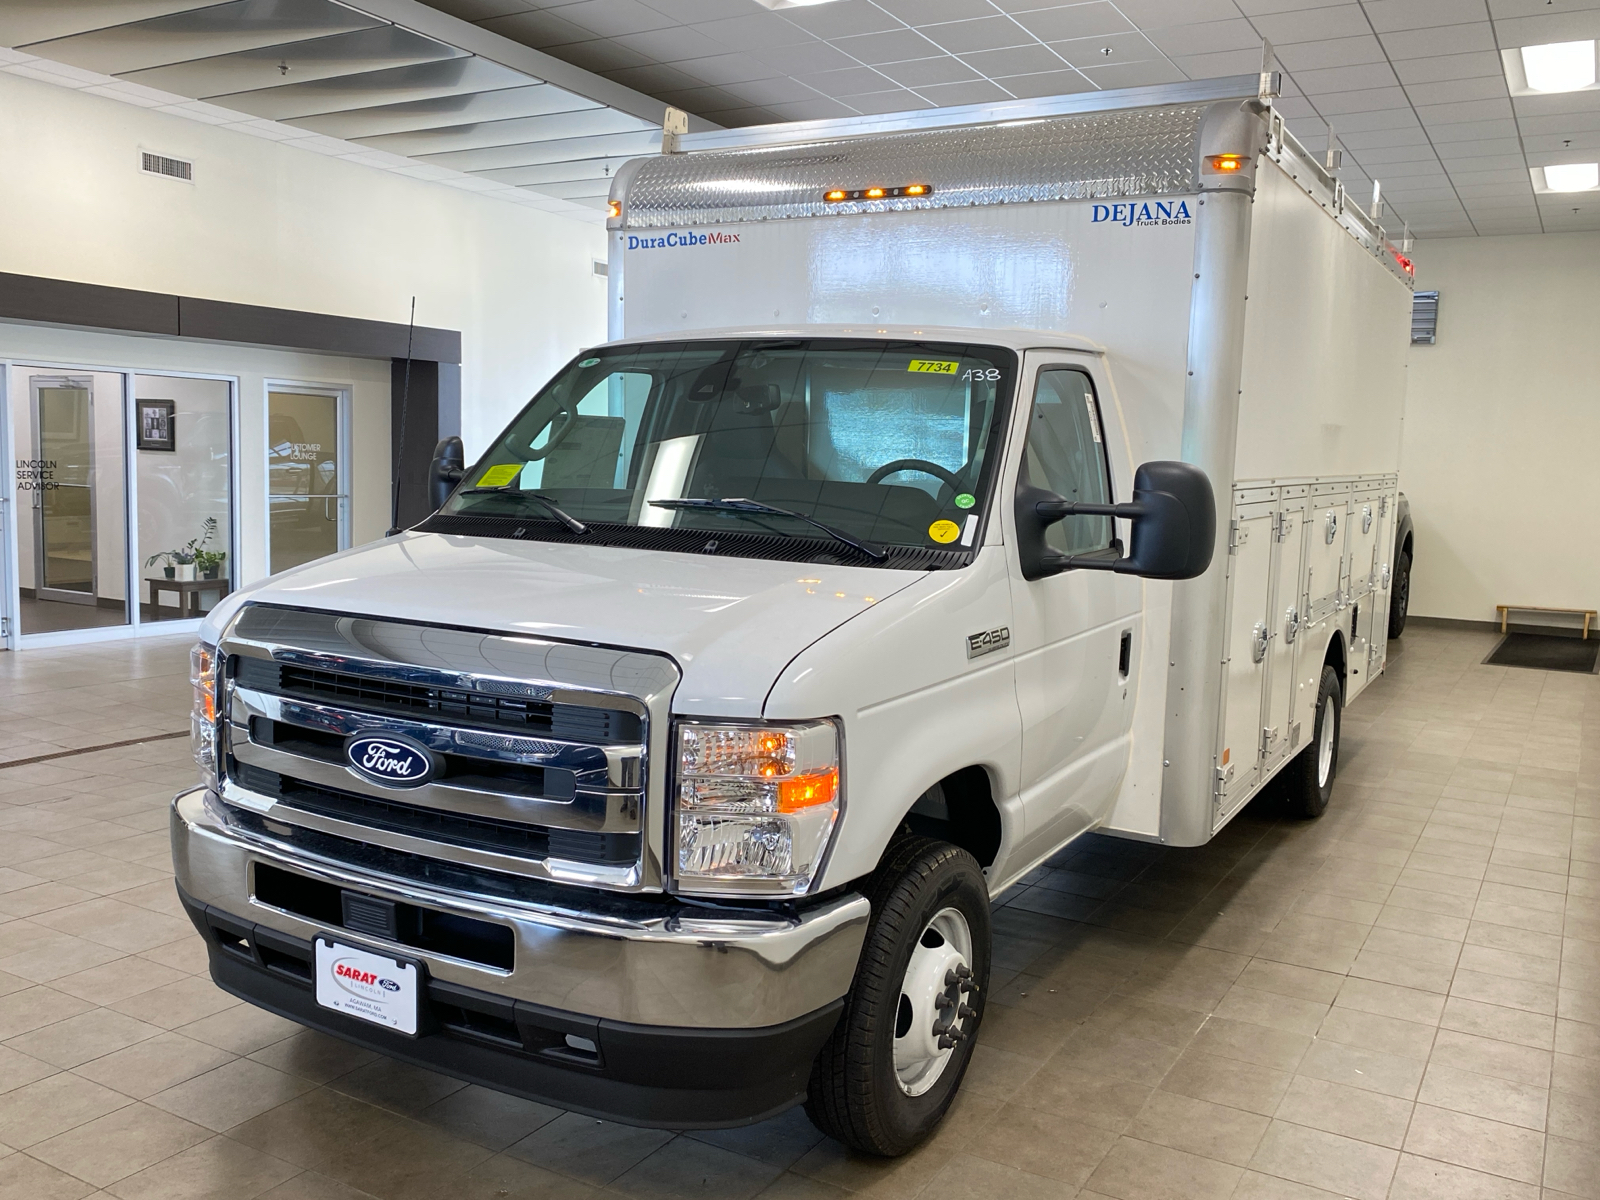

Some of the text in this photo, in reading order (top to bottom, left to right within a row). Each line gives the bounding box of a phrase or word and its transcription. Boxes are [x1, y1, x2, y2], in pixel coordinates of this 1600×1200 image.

[1091, 200, 1192, 227] DEJANA
[1161, 217, 1191, 225] Bodies
[917, 362, 952, 372] 7734
[961, 368, 1001, 382] A38
[290, 452, 317, 460] LOUNGE
[16, 459, 57, 469] LINCOLN
[16, 470, 54, 480] SERVICE
[17, 481, 60, 491] ADVISOR
[363, 743, 413, 775] Ford
[336, 964, 378, 985] SARAT
[354, 982, 381, 996] LINCOLN
